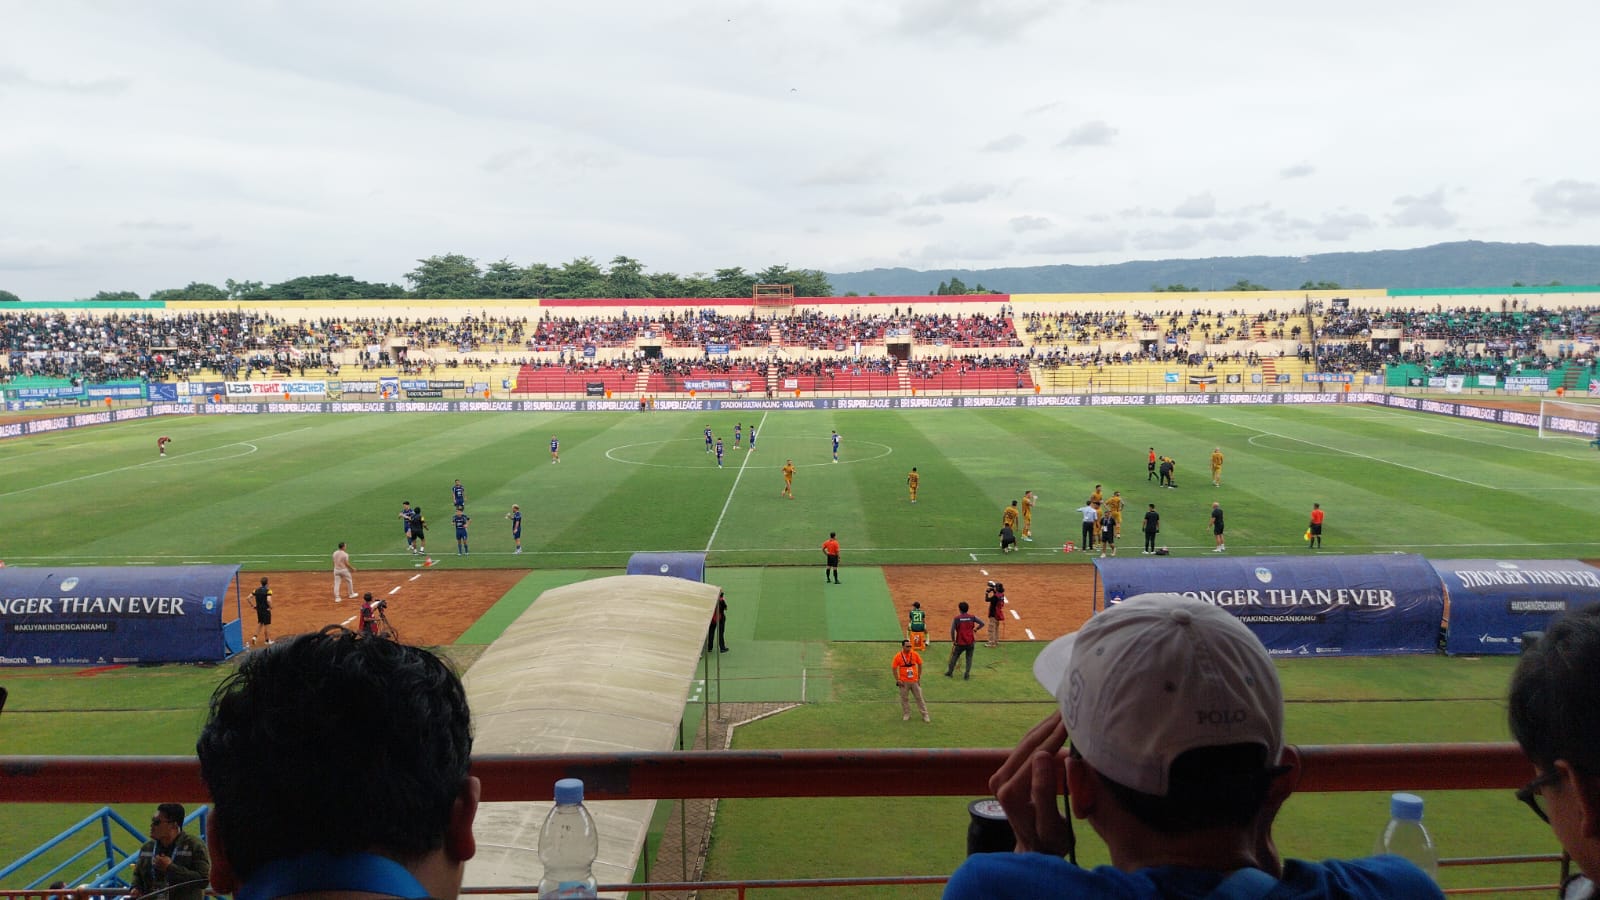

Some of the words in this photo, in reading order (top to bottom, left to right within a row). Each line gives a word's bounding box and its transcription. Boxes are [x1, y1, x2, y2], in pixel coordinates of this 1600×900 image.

[1455, 570, 1526, 588] STRONGER
[1520, 570, 1566, 584] THAN
[1564, 571, 1600, 588] EVER
[60, 598, 124, 614] THAN
[128, 598, 185, 615] EVER
[1266, 589, 1332, 606] THAN
[1338, 589, 1395, 608] EVER
[1240, 615, 1316, 623] YAKINDENGANKAMU
[34, 656, 52, 664] Taro
[1196, 709, 1247, 725] POLO
